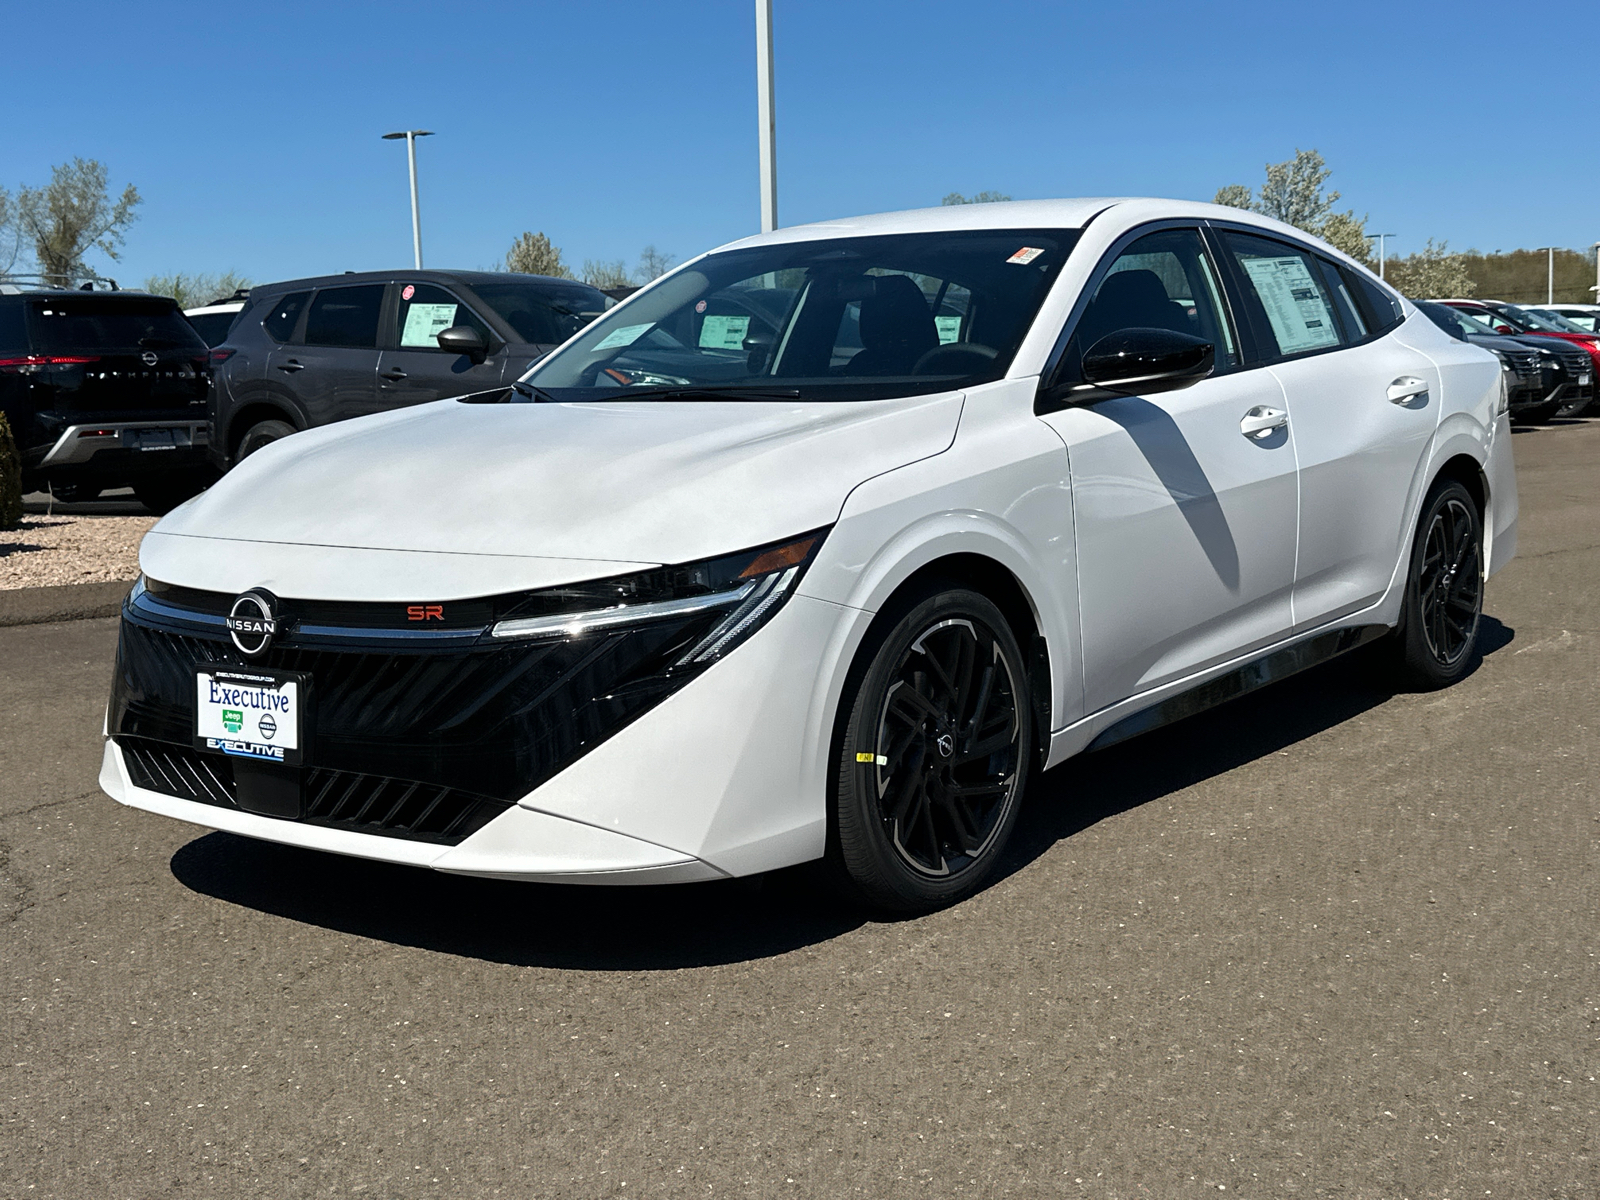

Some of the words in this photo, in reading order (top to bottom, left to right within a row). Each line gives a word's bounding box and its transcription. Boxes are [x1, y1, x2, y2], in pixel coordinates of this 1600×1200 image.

[407, 605, 444, 620] SR
[226, 618, 275, 633] NISSAN
[209, 680, 289, 713] Executive
[225, 711, 241, 721] Jeep
[206, 738, 284, 758] EXECUTIVE
